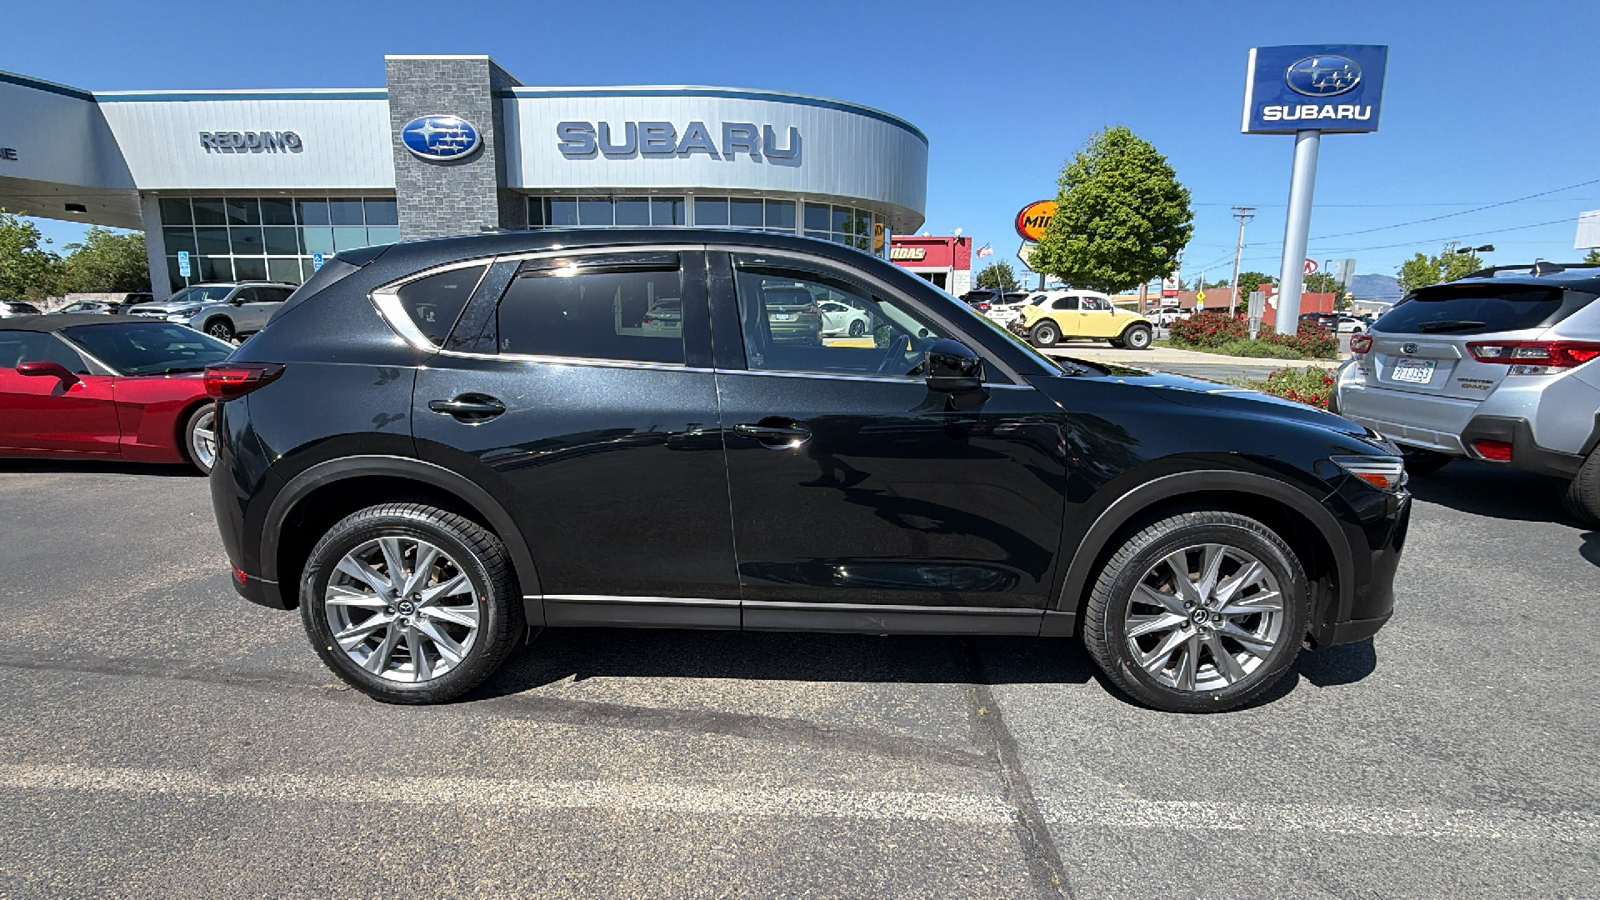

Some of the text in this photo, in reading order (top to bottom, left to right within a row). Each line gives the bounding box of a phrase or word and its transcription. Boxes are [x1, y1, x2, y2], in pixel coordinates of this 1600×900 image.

[1263, 105, 1371, 120] SUBARU
[199, 131, 302, 151] REDDING
[557, 121, 801, 160] SUBARU
[890, 247, 926, 259] IDAS
